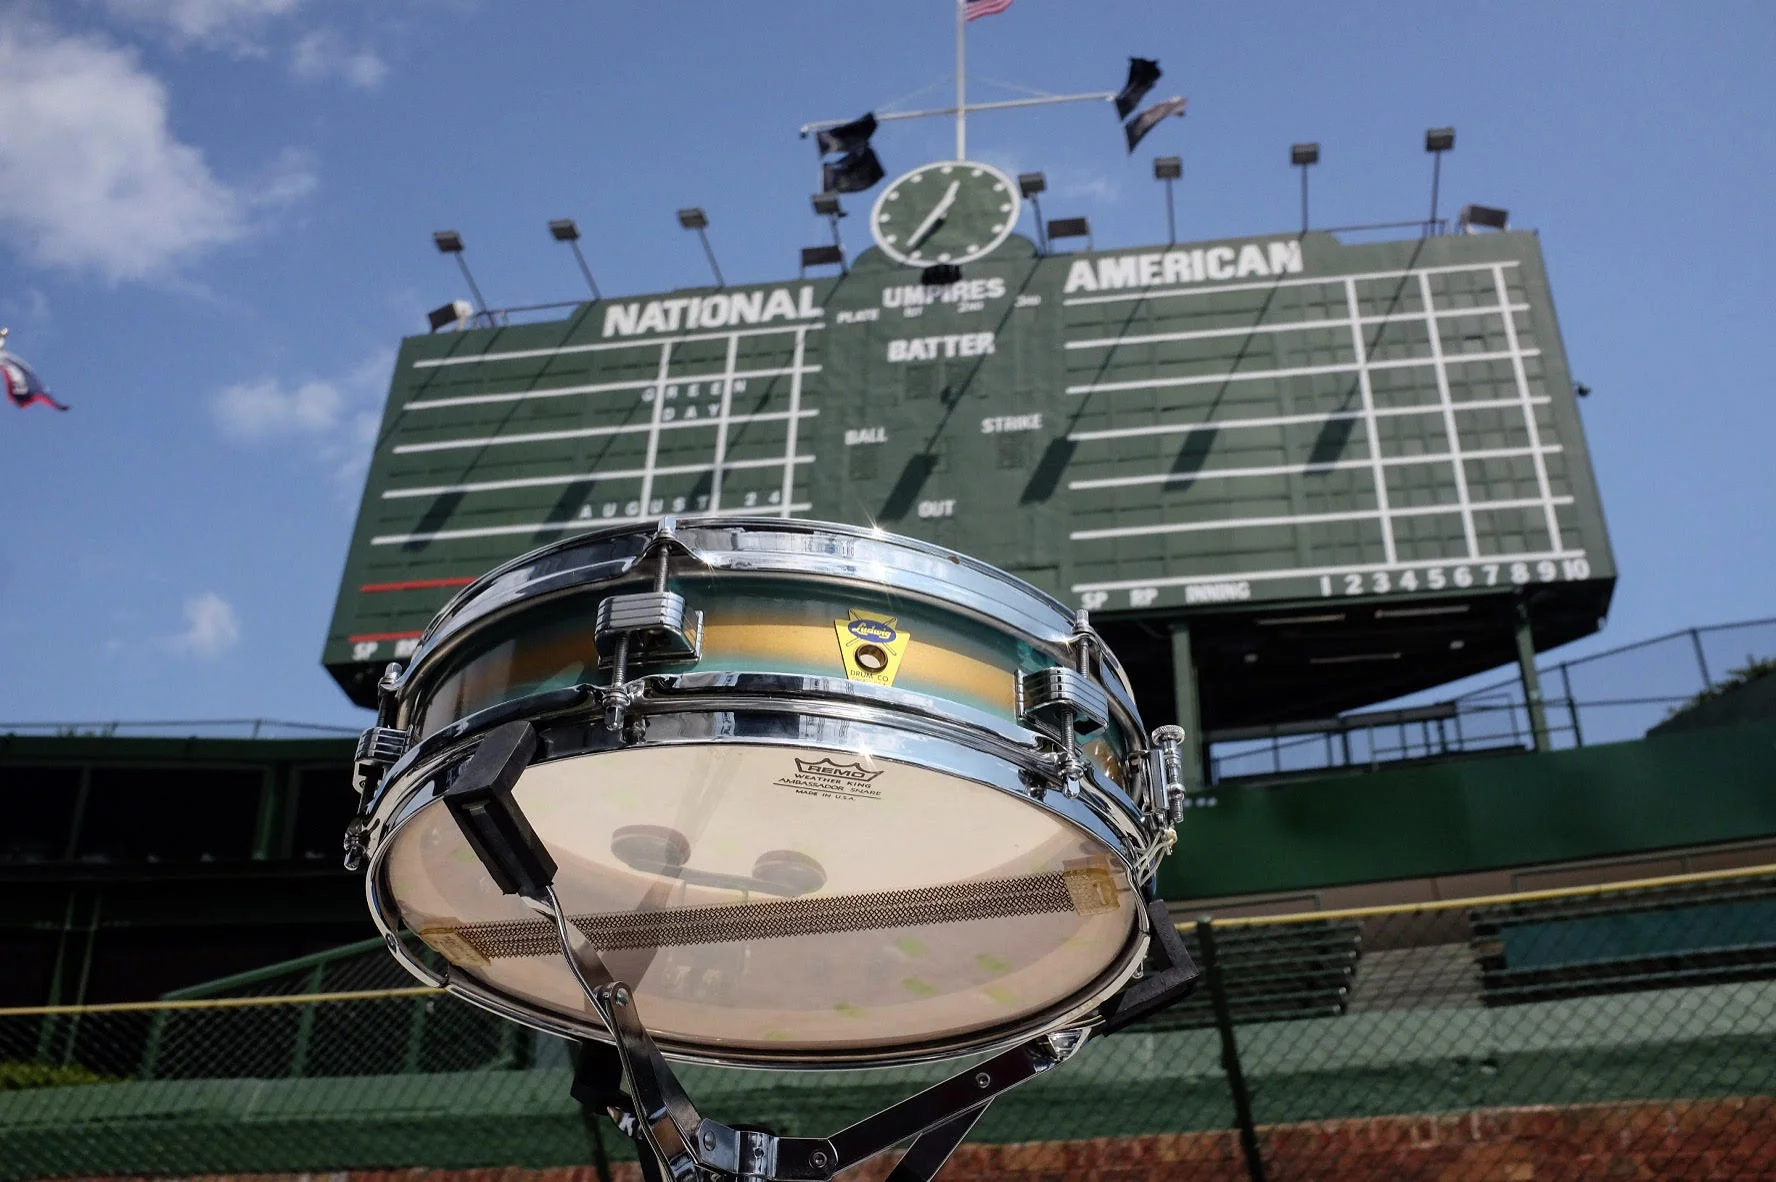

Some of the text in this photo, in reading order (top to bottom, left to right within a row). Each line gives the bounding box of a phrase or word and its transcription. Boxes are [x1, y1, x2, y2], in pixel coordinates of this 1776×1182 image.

[1064, 240, 1304, 293] AMERICAN
[882, 278, 1006, 308] UMPIRES
[602, 286, 825, 337] NATIONAL
[836, 307, 880, 324] PLATE
[887, 332, 996, 362] BATTER
[641, 378, 747, 402] GREEN
[662, 403, 721, 421] DAY
[981, 413, 1043, 434] STRIKE
[845, 427, 888, 445] BALL
[578, 490, 781, 520] AUGUST 24
[918, 499, 956, 518] OUT
[1081, 590, 1108, 609] SP
[1320, 575, 1331, 596] 1
[1344, 574, 1363, 595] 2
[1372, 572, 1391, 593] 3
[1400, 570, 1418, 591] 4
[1427, 568, 1446, 590] 5
[1454, 566, 1473, 588] 6
[1482, 565, 1499, 586] 7
[1510, 562, 1530, 584] 8
[1537, 560, 1556, 582] 9
[1562, 558, 1590, 581] 10
[851, 622, 892, 640] Ludwig
[352, 640, 378, 660] SP
[850, 670, 873, 679] DRUM
[794, 773, 872, 789] WEATHER KING
[807, 765, 866, 778] REMO
[779, 778, 882, 796] AMBASSADOR SNARE
